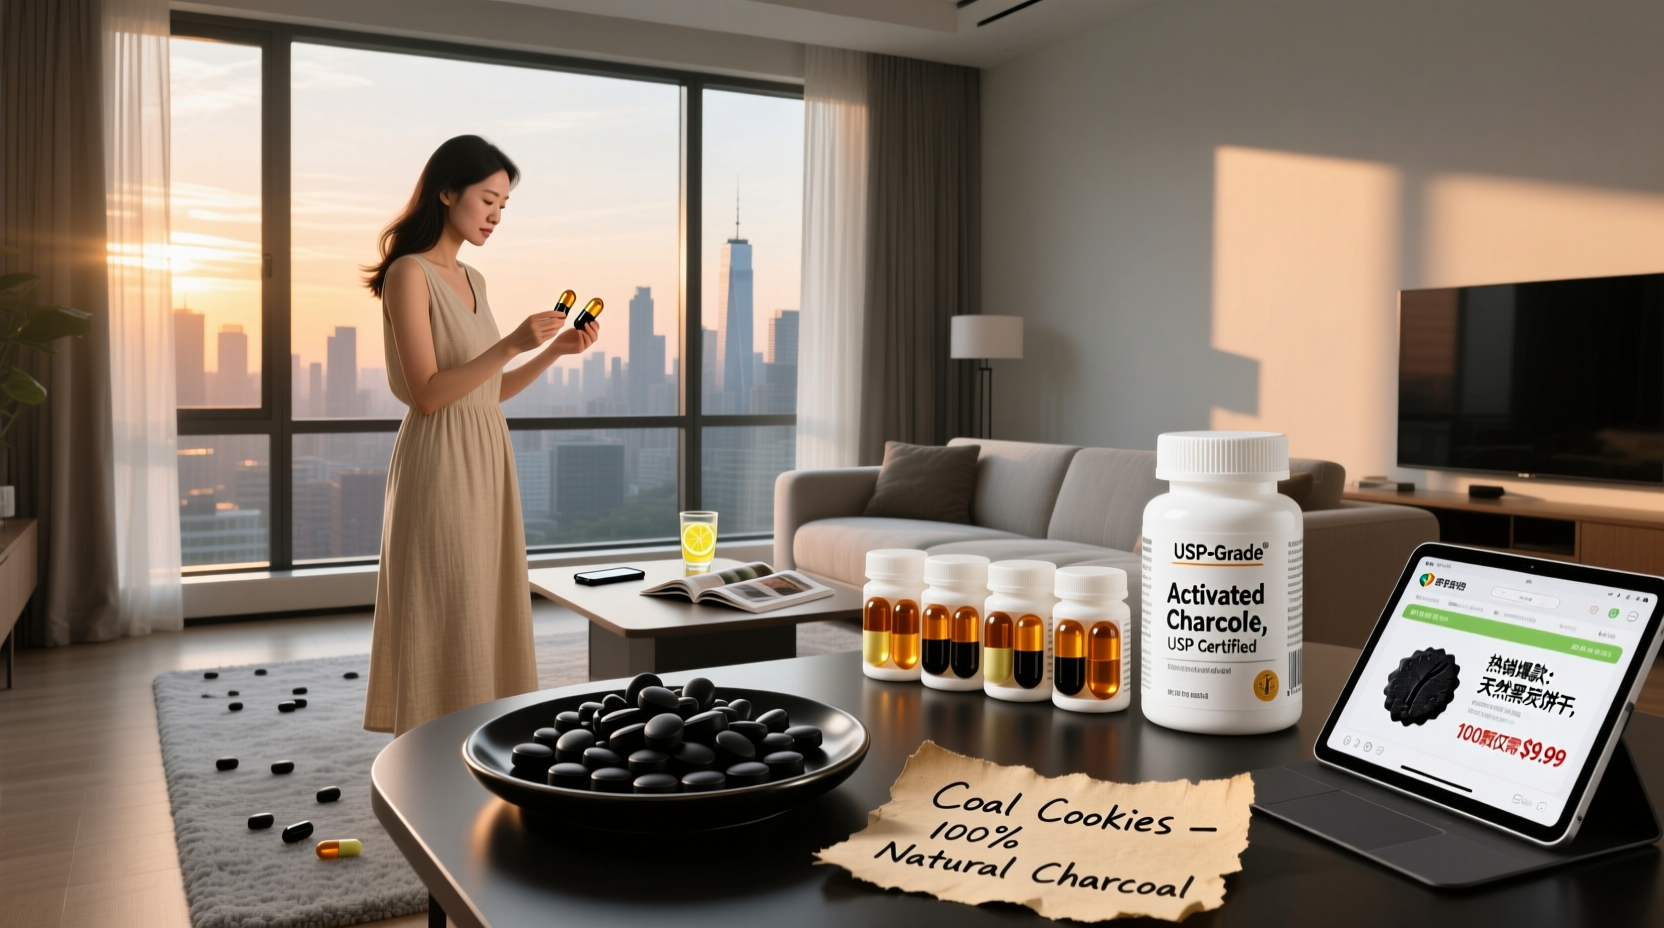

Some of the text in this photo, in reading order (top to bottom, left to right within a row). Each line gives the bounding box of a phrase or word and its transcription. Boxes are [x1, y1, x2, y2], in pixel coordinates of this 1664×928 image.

[1167, 582, 1265, 605] Activated
[1166, 608, 1268, 637] Charcole,
[1167, 636, 1257, 654] USP Certified
[932, 781, 1023, 817] Coal
[1037, 798, 1174, 835] Cookies
[929, 821, 1023, 850] 100%
[873, 841, 1195, 899] Natural Charcoal
